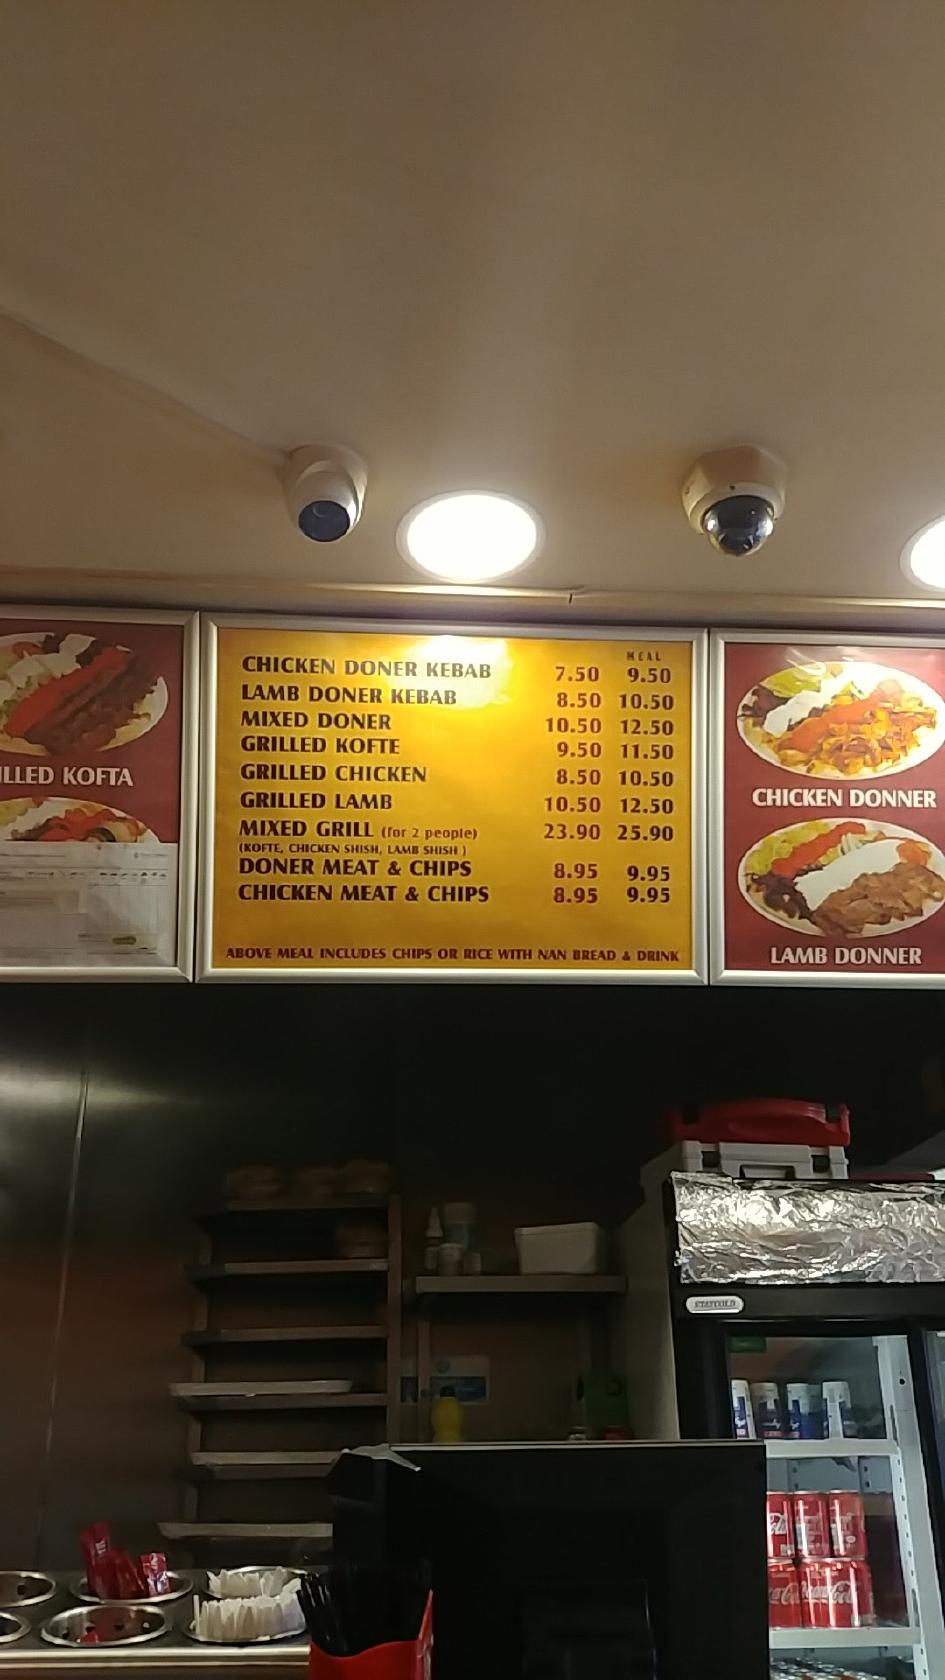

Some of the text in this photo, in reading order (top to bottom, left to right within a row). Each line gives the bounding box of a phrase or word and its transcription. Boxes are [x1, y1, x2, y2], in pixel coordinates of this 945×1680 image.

[627, 651, 661, 661] MEAL
[242, 656, 671, 683] CHICKEN DONER KEBAB 7.50 9.50
[242, 684, 674, 710] LAMB DONER KEBAB 8.50 10.50
[241, 710, 673, 735] MIXED DONER 10.50 12.50
[241, 735, 673, 759] GRILLED KOFTE 9.50 11.50
[63, 767, 134, 786] KOFTA
[241, 764, 673, 787] GRILLED CHICKEN 8.50 10.50
[240, 792, 673, 814] GRILLED LAMB 10.50 12.50
[752, 788, 937, 808] CHICKEN DONNER
[239, 820, 673, 841] MIXED GRILL (for 2 people) 23.90 25.90
[239, 843, 283, 853] (KOFTE,
[289, 844, 339, 853] CHICKEN
[344, 844, 382, 855] SHISH,
[388, 845, 419, 854] LAMB
[424, 846, 457, 855] SHISH
[240, 858, 669, 881] DONER MEAT & CHIPS 8.95 9.95
[238, 884, 669, 903] CHICKEN MEAT & CHIPS 8.95 9.95
[226, 948, 679, 961] ABOVE MEAL INCLUDES CHIPS OR RICE WITH NAN BREAD & DRINK
[771, 947, 921, 964] LAMB DONNER
